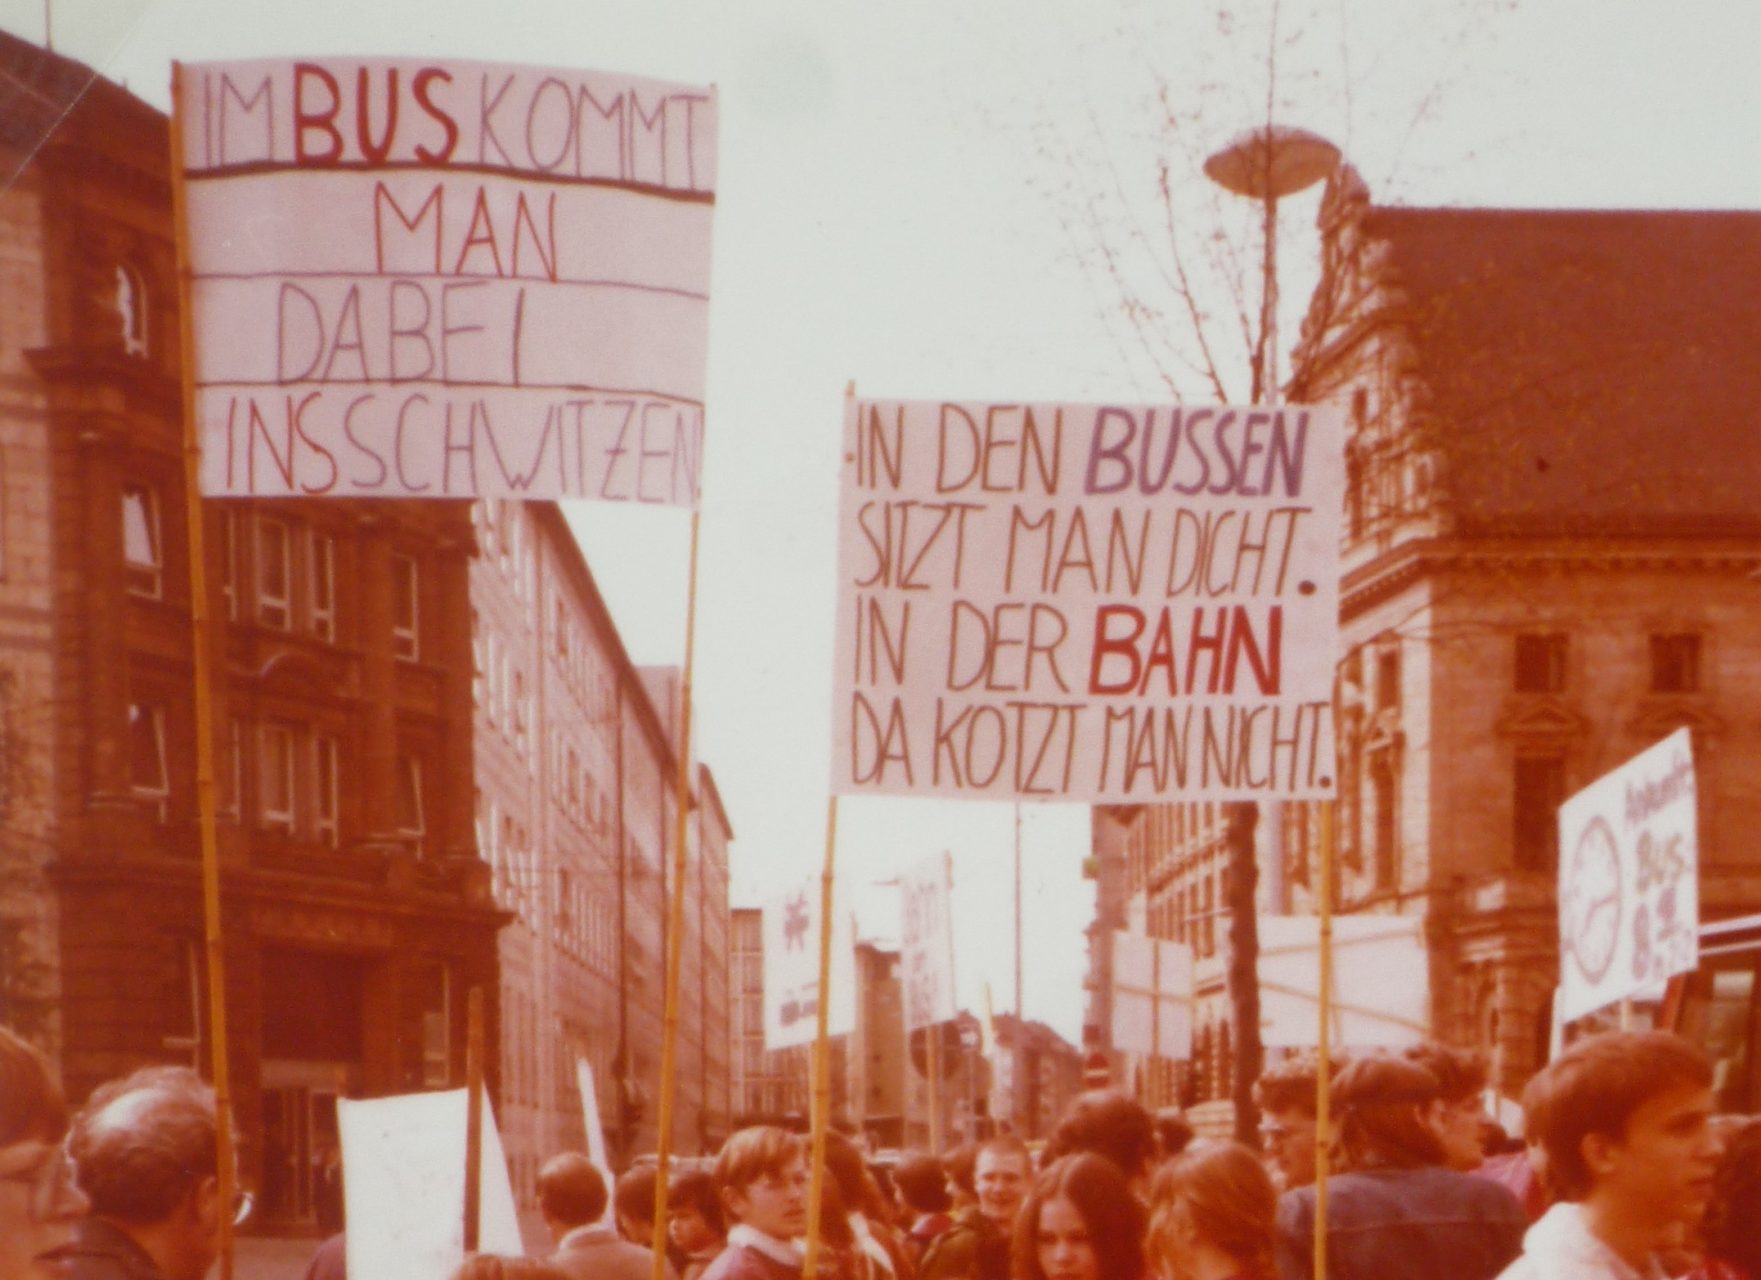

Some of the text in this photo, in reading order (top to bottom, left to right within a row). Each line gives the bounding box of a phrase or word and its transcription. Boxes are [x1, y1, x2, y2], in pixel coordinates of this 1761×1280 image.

[204, 63, 710, 190] IM BUS KOMMT
[374, 180, 558, 283] MAN
[277, 279, 527, 388] DABEI
[857, 403, 1310, 497] IN DEN BUSSEN
[854, 501, 1316, 598] SITZT MAN DICHT.
[854, 594, 1283, 697] IN DER BAHN
[853, 691, 1333, 794] DA KOTZT MAN NICHT.
